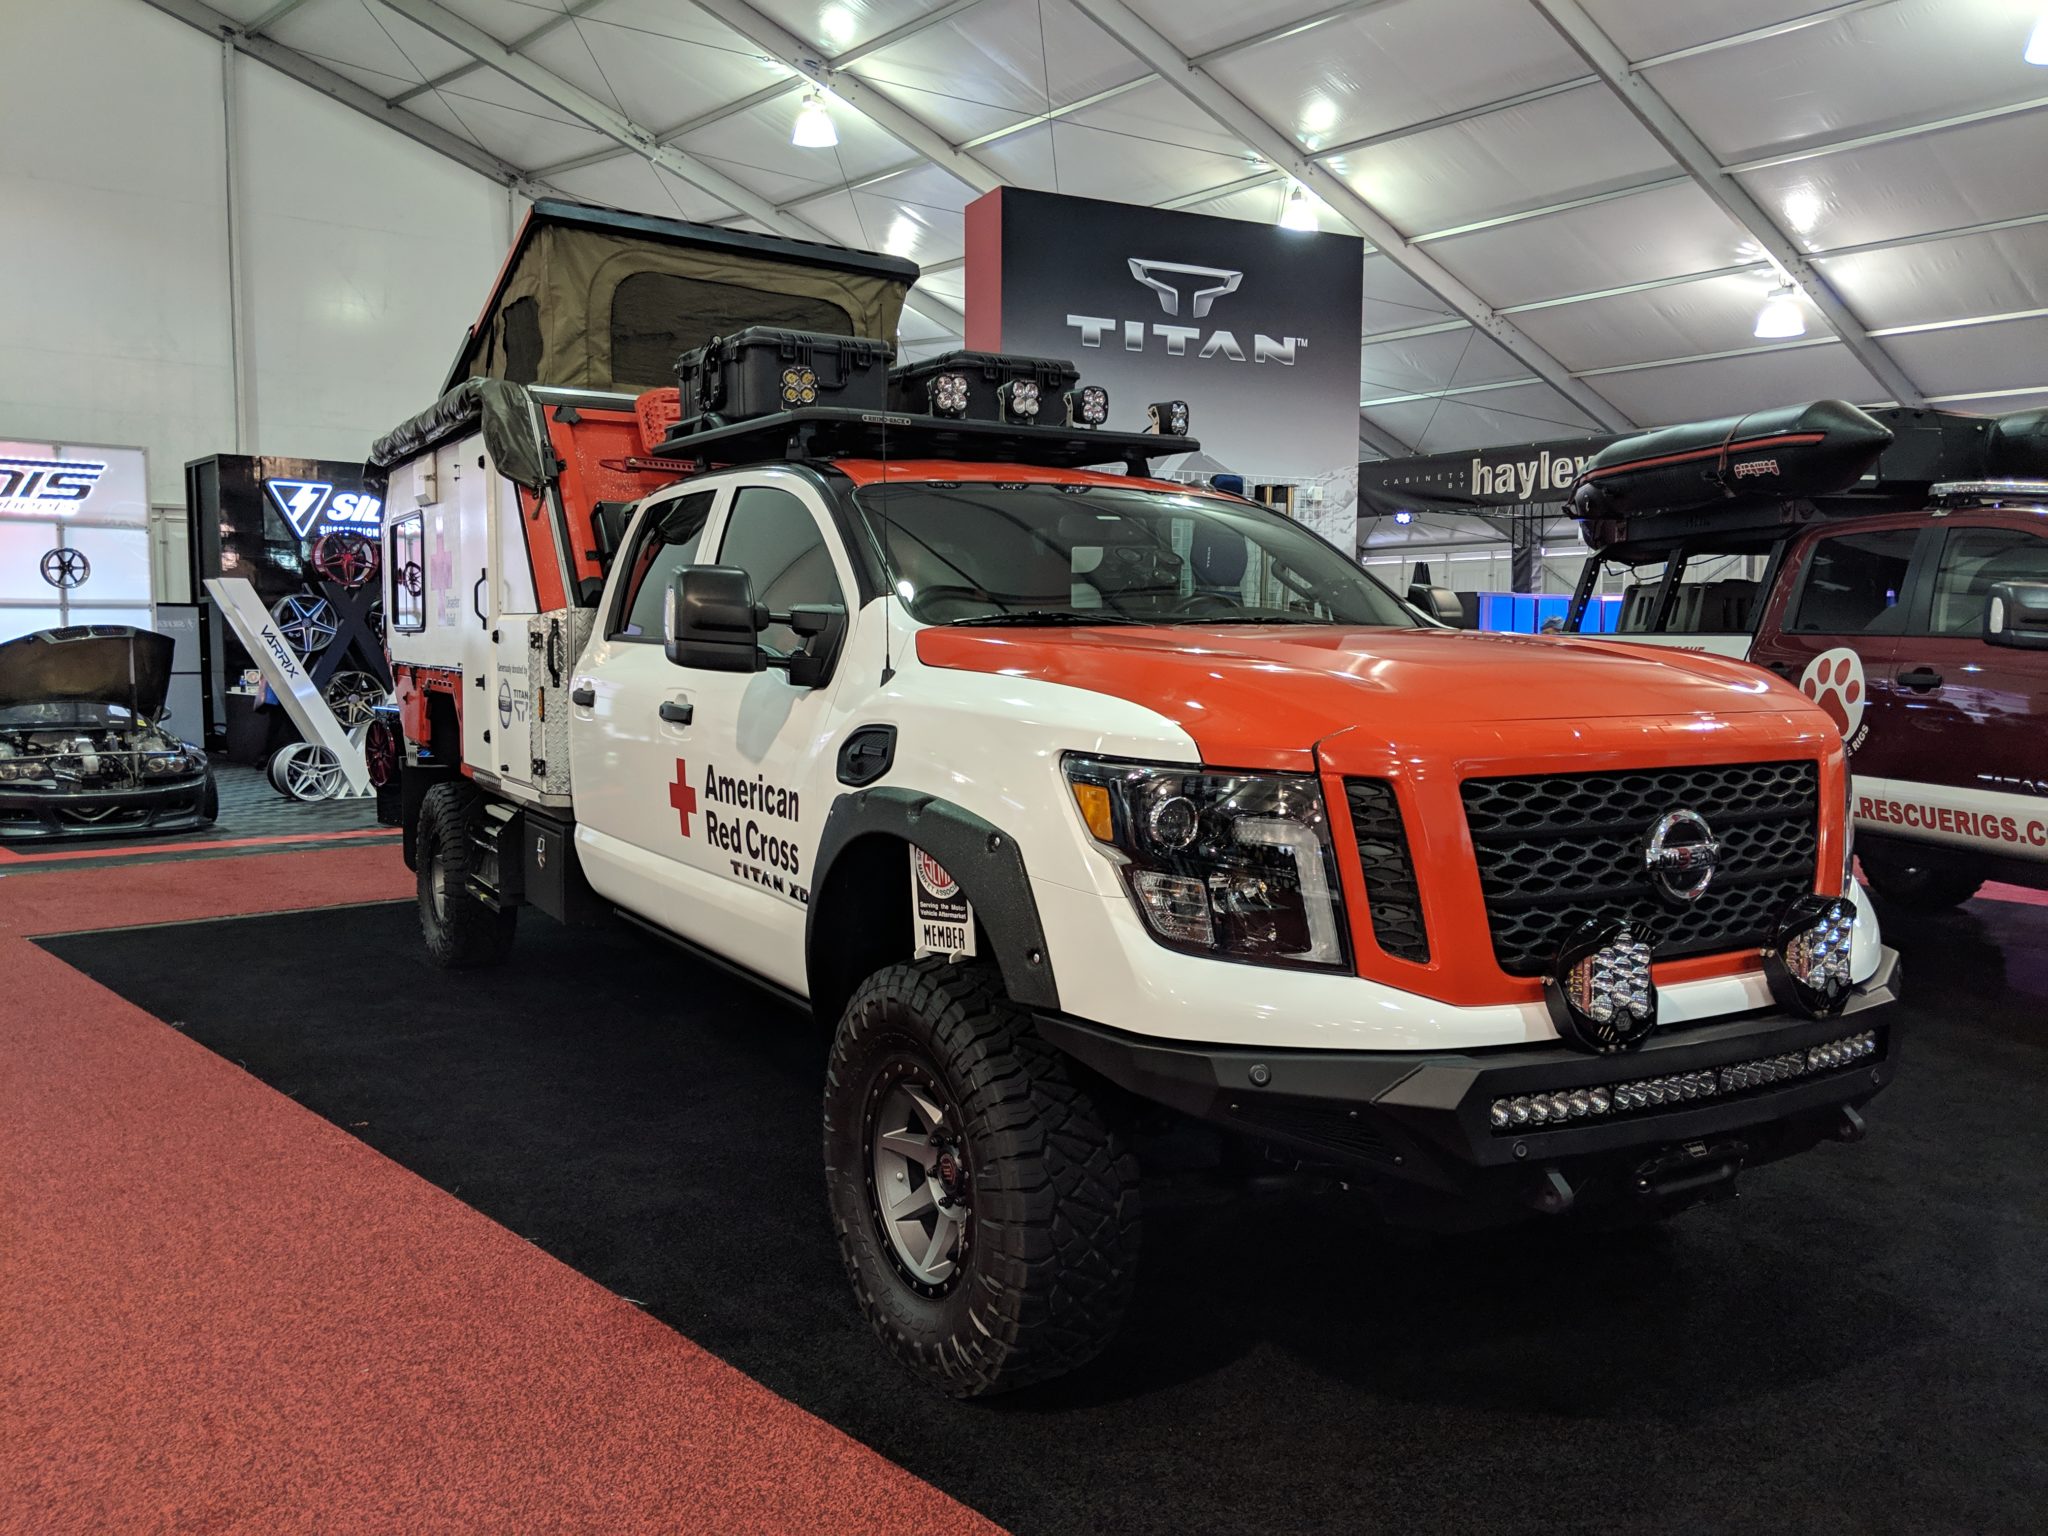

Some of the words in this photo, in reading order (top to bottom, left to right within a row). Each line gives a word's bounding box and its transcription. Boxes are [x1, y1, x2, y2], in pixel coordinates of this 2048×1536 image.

[1382, 471, 1465, 487] CABINETS
[1448, 481, 1465, 489] BY
[260, 624, 300, 680] VARRIX
[1851, 724, 1869, 751] RIGS
[704, 764, 799, 823] American
[705, 809, 742, 855] Red
[745, 820, 800, 876] Cross
[730, 859, 785, 894] TITAN
[788, 881, 809, 905] XD
[920, 901, 938, 910] Serving
[920, 909, 938, 917] Vehicle
[938, 911, 967, 920] Aftermarket
[923, 924, 966, 950] MEMBER
